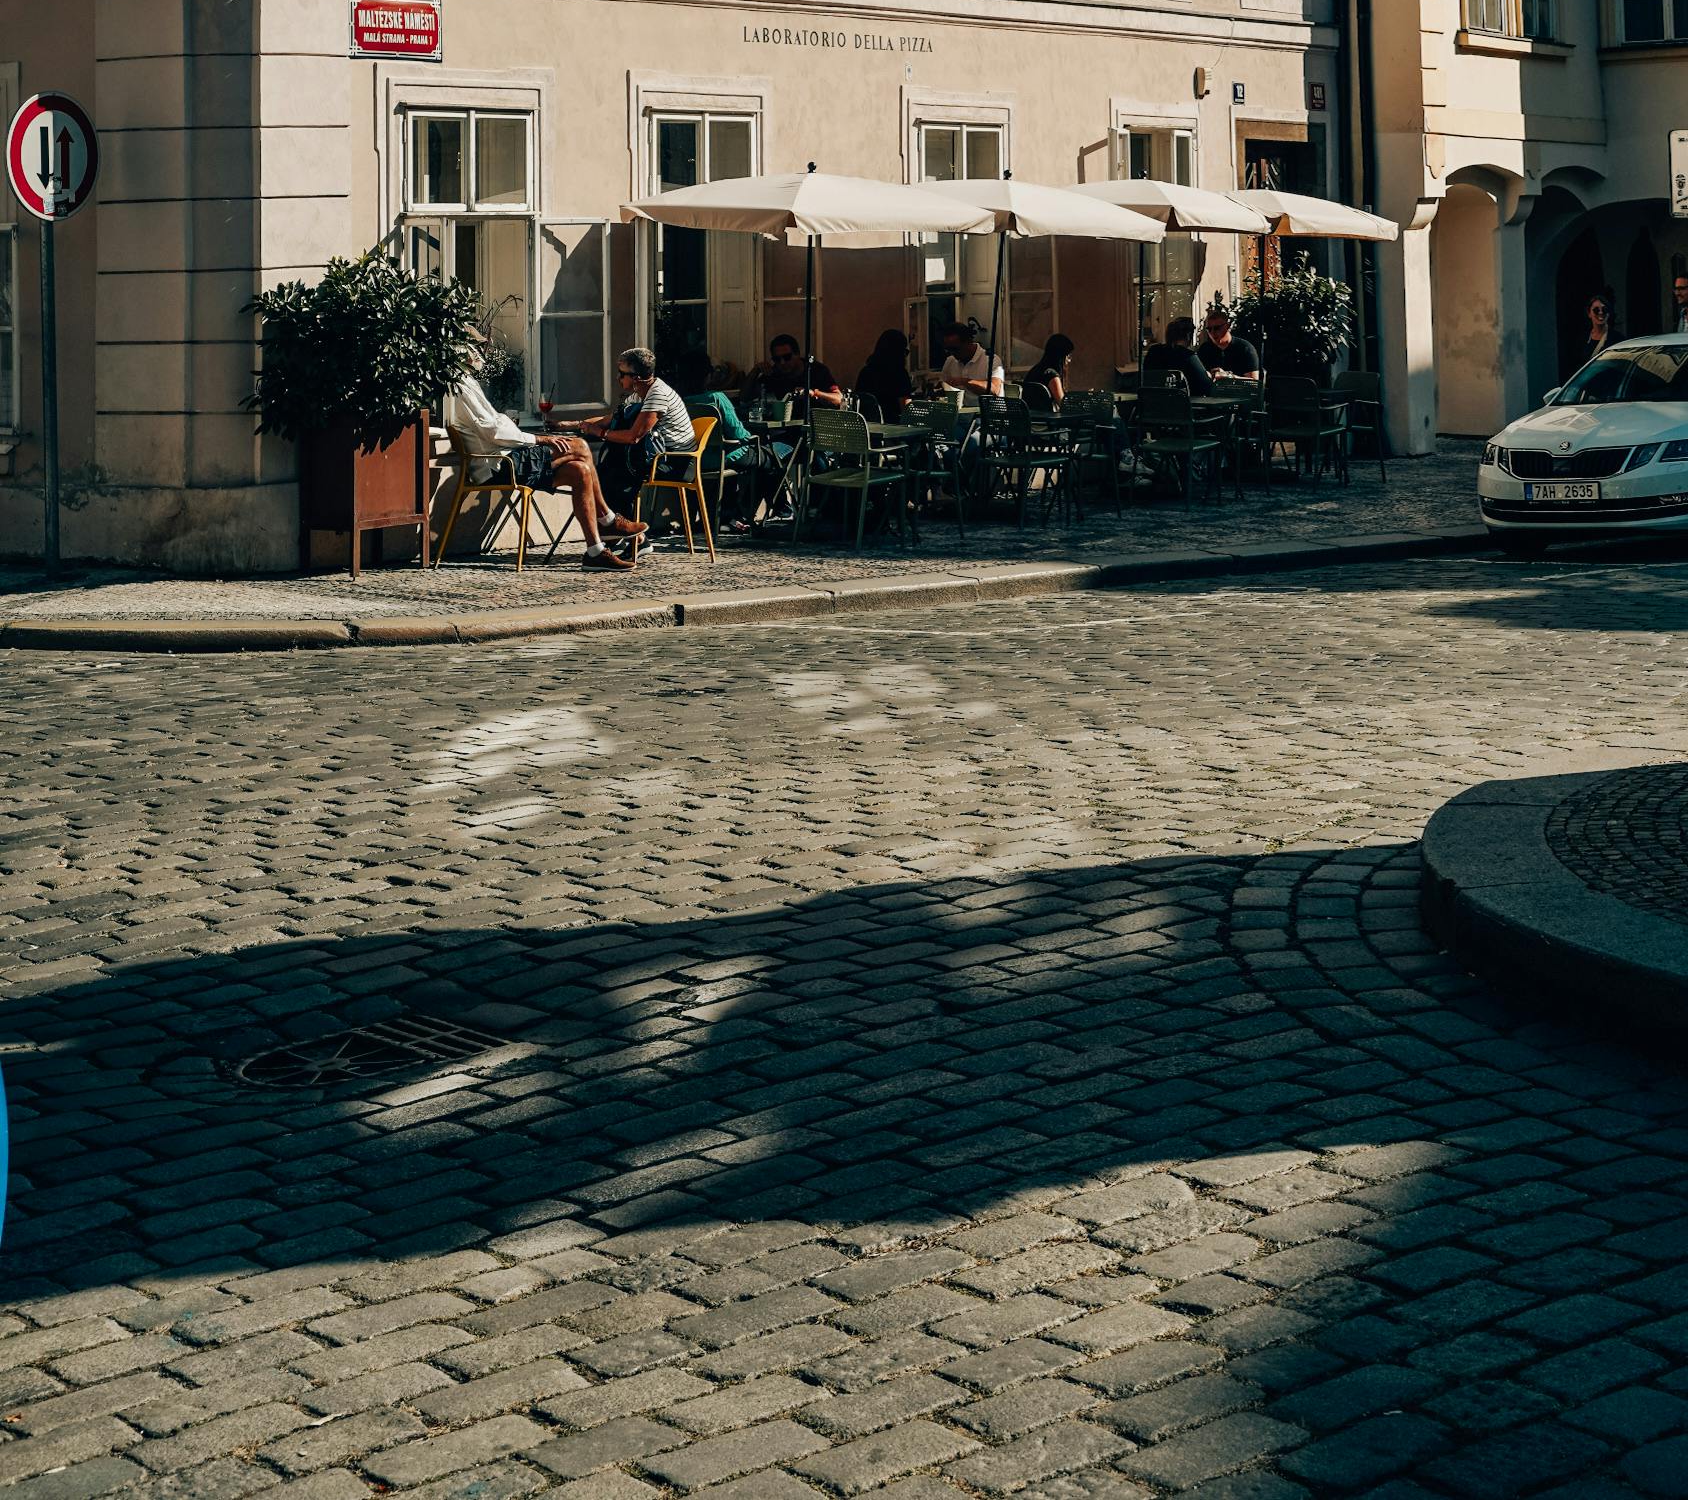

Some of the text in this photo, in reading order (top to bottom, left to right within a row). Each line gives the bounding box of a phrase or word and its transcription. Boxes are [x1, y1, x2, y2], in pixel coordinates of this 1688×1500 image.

[358, 7, 435, 31] MALTÉZSKÉ NÁMĚSTÍ
[363, 31, 380, 42] MALÁ
[382, 32, 405, 44] STRANA
[410, 35, 428, 45] PRAHA
[429, 36, 433, 45] 1
[743, 26, 933, 52] LABORATORIO DELLA PIZZA
[1535, 485, 1593, 498] 7AH 2635
